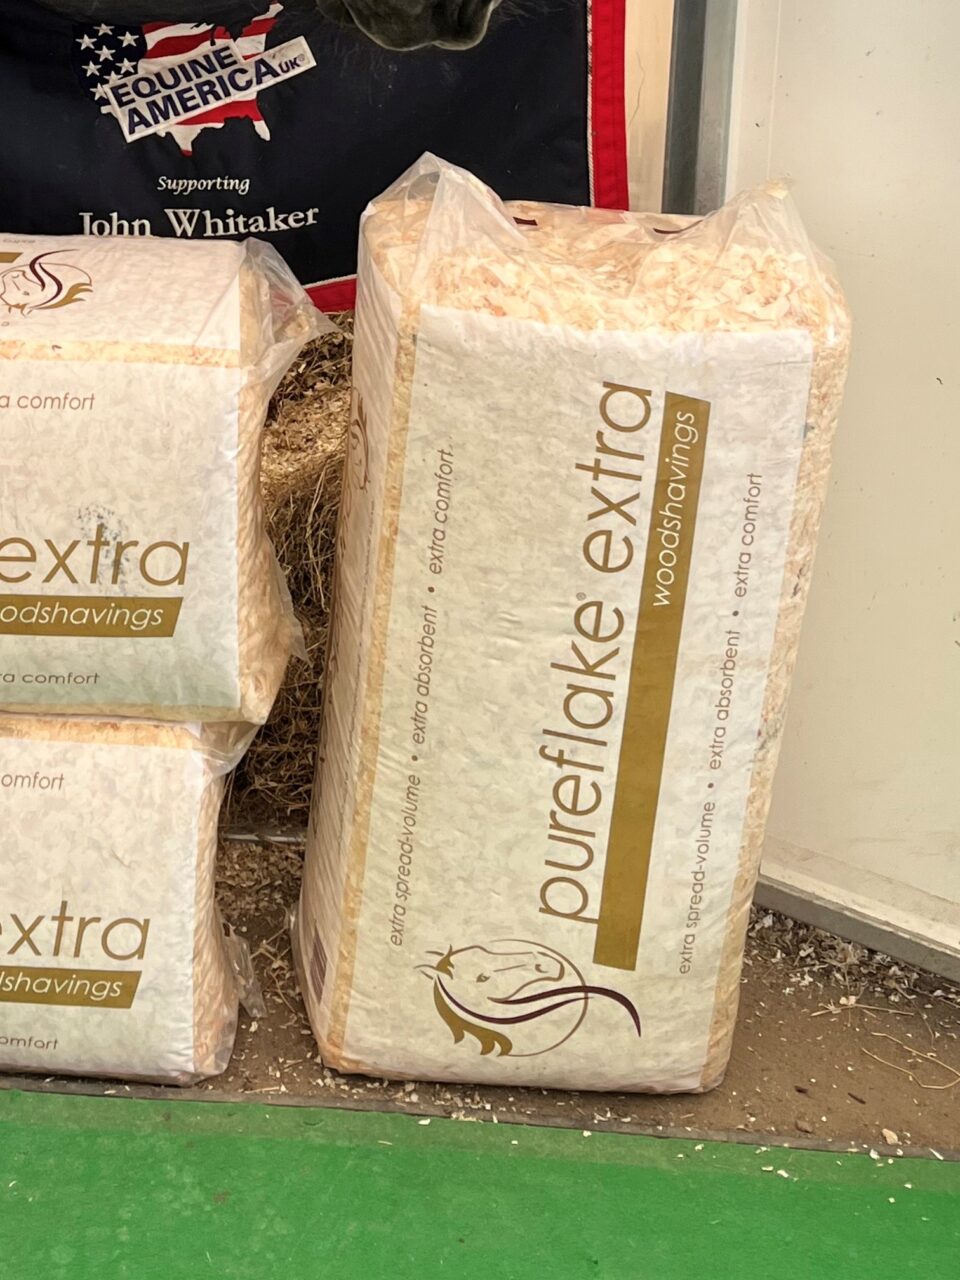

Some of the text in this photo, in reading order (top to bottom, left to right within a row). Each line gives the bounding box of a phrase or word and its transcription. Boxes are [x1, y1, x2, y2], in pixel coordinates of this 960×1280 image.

[111, 45, 239, 108] EQUINE
[126, 57, 280, 135] AMERICA
[157, 175, 250, 195] Supporting
[78, 206, 319, 237] John Whitaker
[16, 392, 96, 411] comfort
[575, 381, 652, 574] extra
[652, 410, 699, 608] woodshavings
[22, 671, 100, 686] comfort
[390, 446, 456, 948] extra spread-volume extra absorbent extra comfort
[679, 472, 763, 975] extra spread-volume extra absorbent extra comfort
